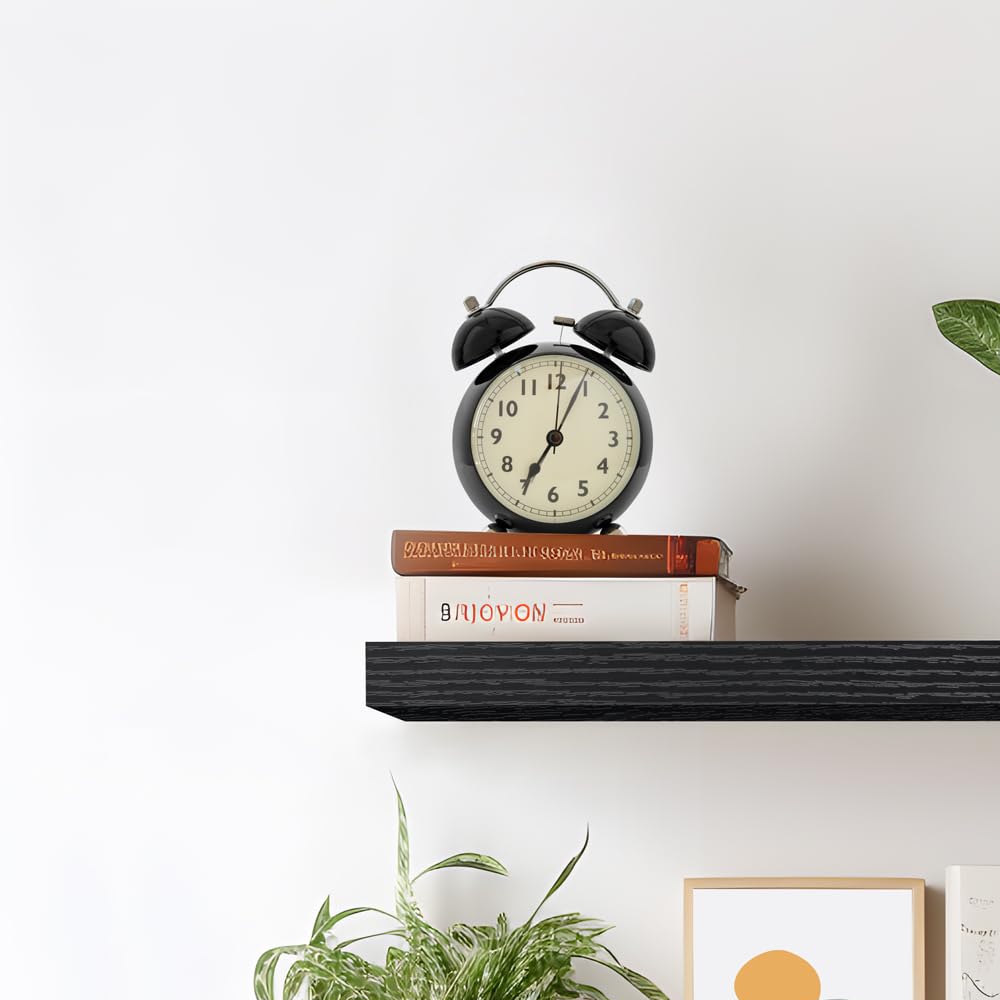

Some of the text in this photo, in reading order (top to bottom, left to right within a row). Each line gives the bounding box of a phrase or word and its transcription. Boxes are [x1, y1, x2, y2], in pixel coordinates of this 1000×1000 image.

[521, 379, 536, 395] 11
[548, 374, 566, 390] 12
[583, 381, 588, 396] 1
[499, 401, 518, 417] 10
[598, 403, 609, 419] 2
[491, 428, 502, 444] 9
[608, 431, 619, 447] 3
[502, 456, 513, 472] 8
[597, 458, 608, 474] 4
[548, 487, 559, 503] 6
[578, 480, 588, 496] 5
